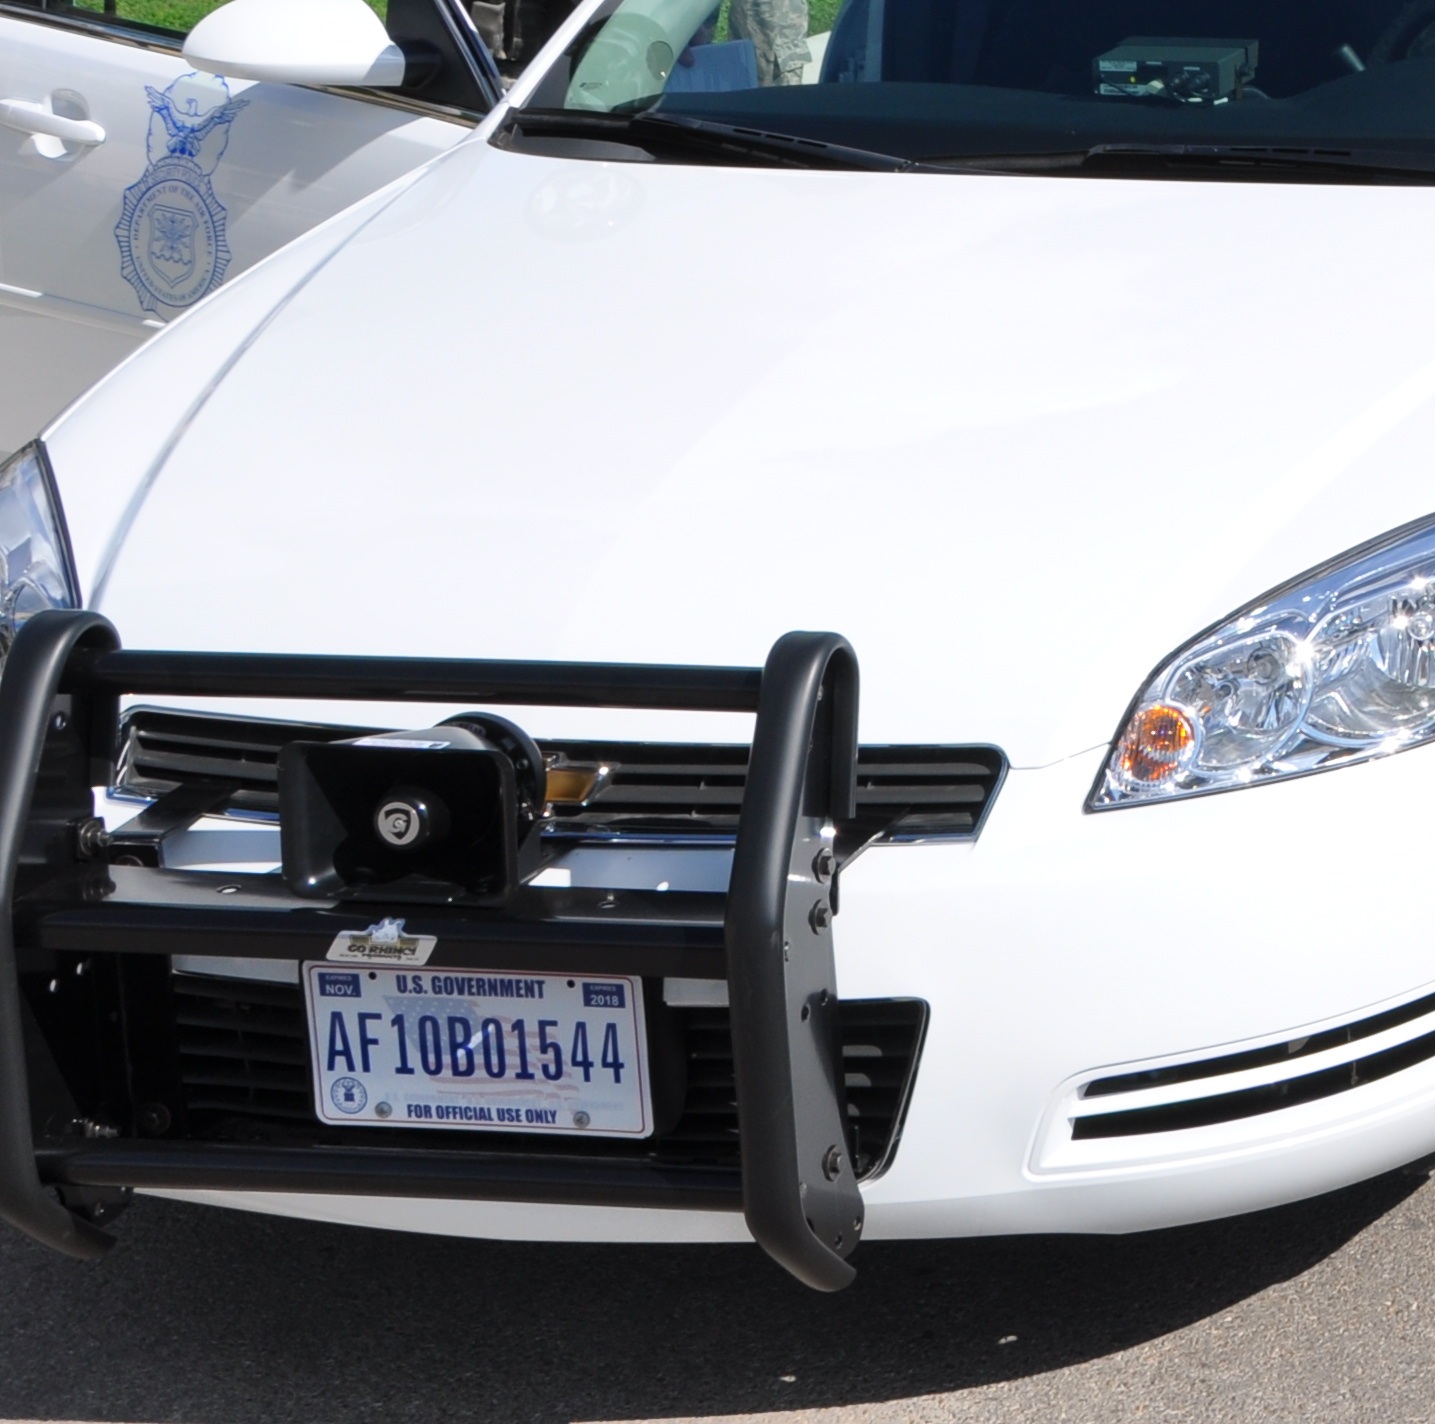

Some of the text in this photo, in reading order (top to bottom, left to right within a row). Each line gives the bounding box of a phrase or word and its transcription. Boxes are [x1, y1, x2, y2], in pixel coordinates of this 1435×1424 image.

[347, 944, 366, 953] GO
[325, 983, 357, 996] NOV.
[396, 974, 545, 999] U.S. GOVERNMENT
[590, 994, 619, 1007] 2018
[326, 1011, 625, 1084] AF10B01544
[407, 1104, 558, 1125] FOR OFFICIAL USE ONLY
